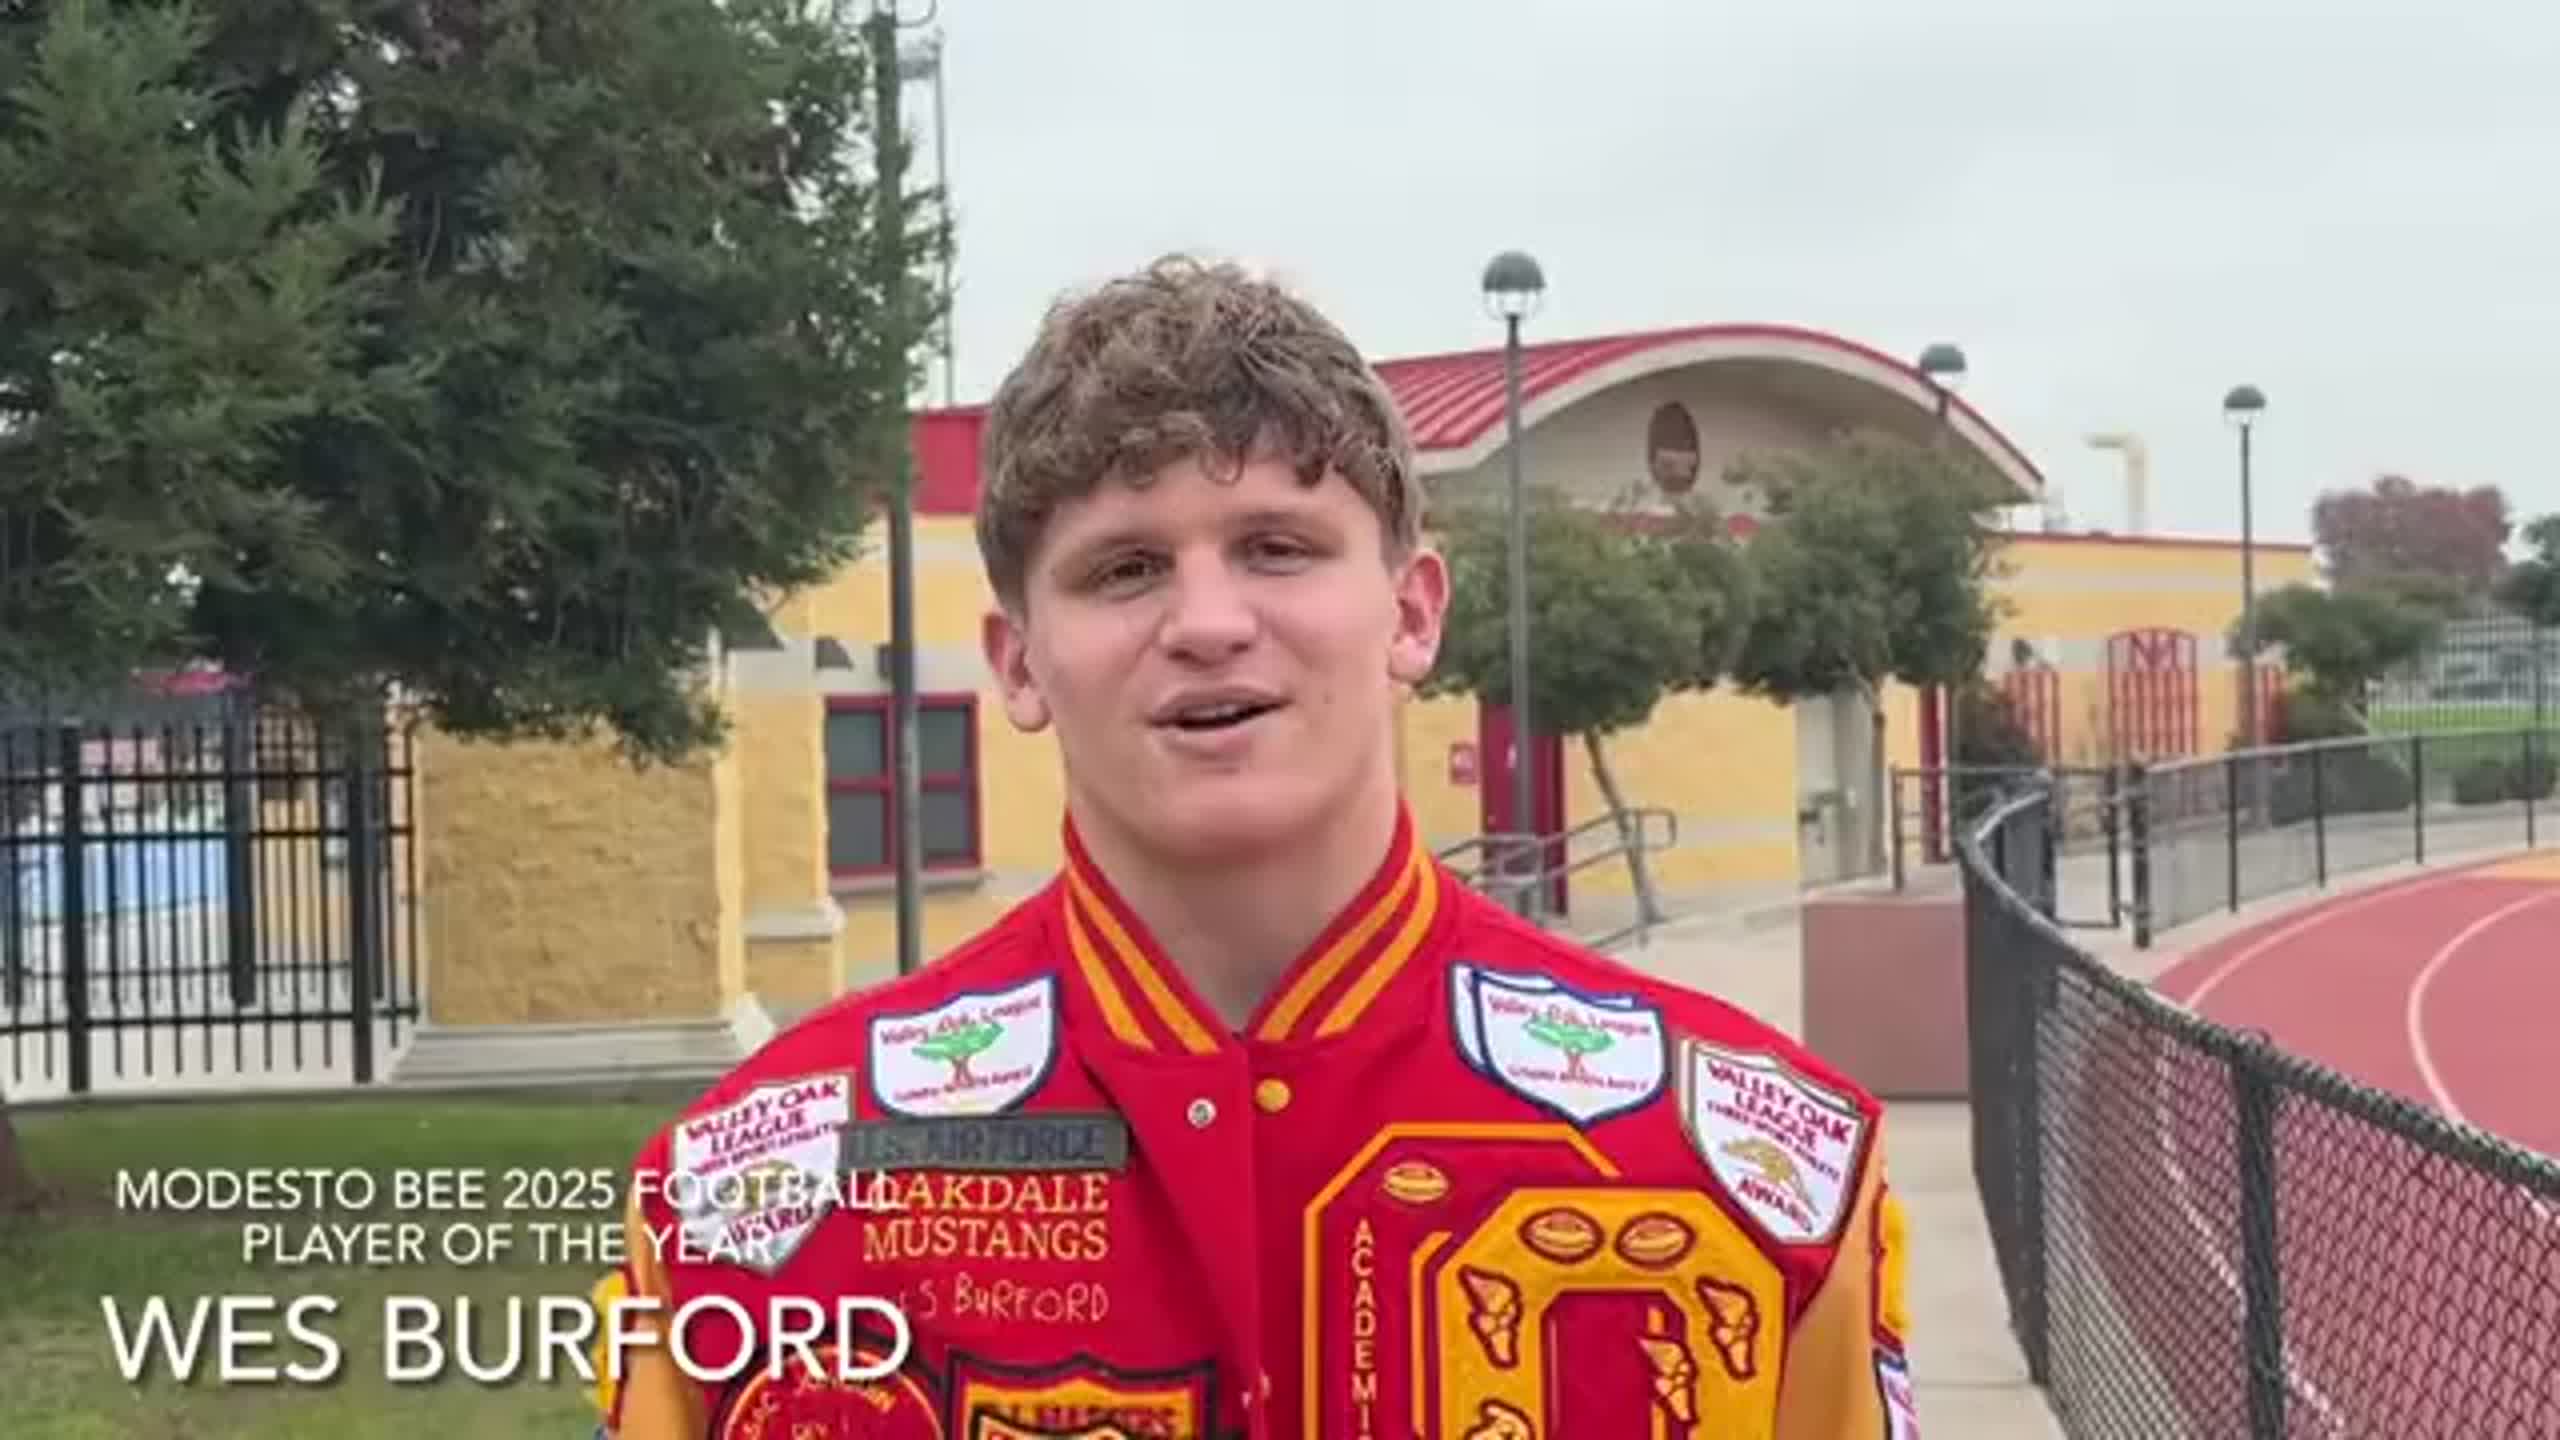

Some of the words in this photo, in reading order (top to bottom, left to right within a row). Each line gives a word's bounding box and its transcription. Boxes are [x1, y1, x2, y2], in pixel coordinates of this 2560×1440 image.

[687, 1096, 773, 1141] VALLEY
[778, 1081, 841, 1109] OAK
[711, 1108, 805, 1156] LEAGUE
[1707, 1059, 1794, 1108] VALLEY
[1797, 1102, 1853, 1146] OAK
[1734, 1090, 1817, 1149] LEAGUE
[867, 1174, 1109, 1213] OAKDALE
[863, 1216, 1109, 1262] MUSTANGS
[1351, 1216, 1377, 1440] ACADEMI
